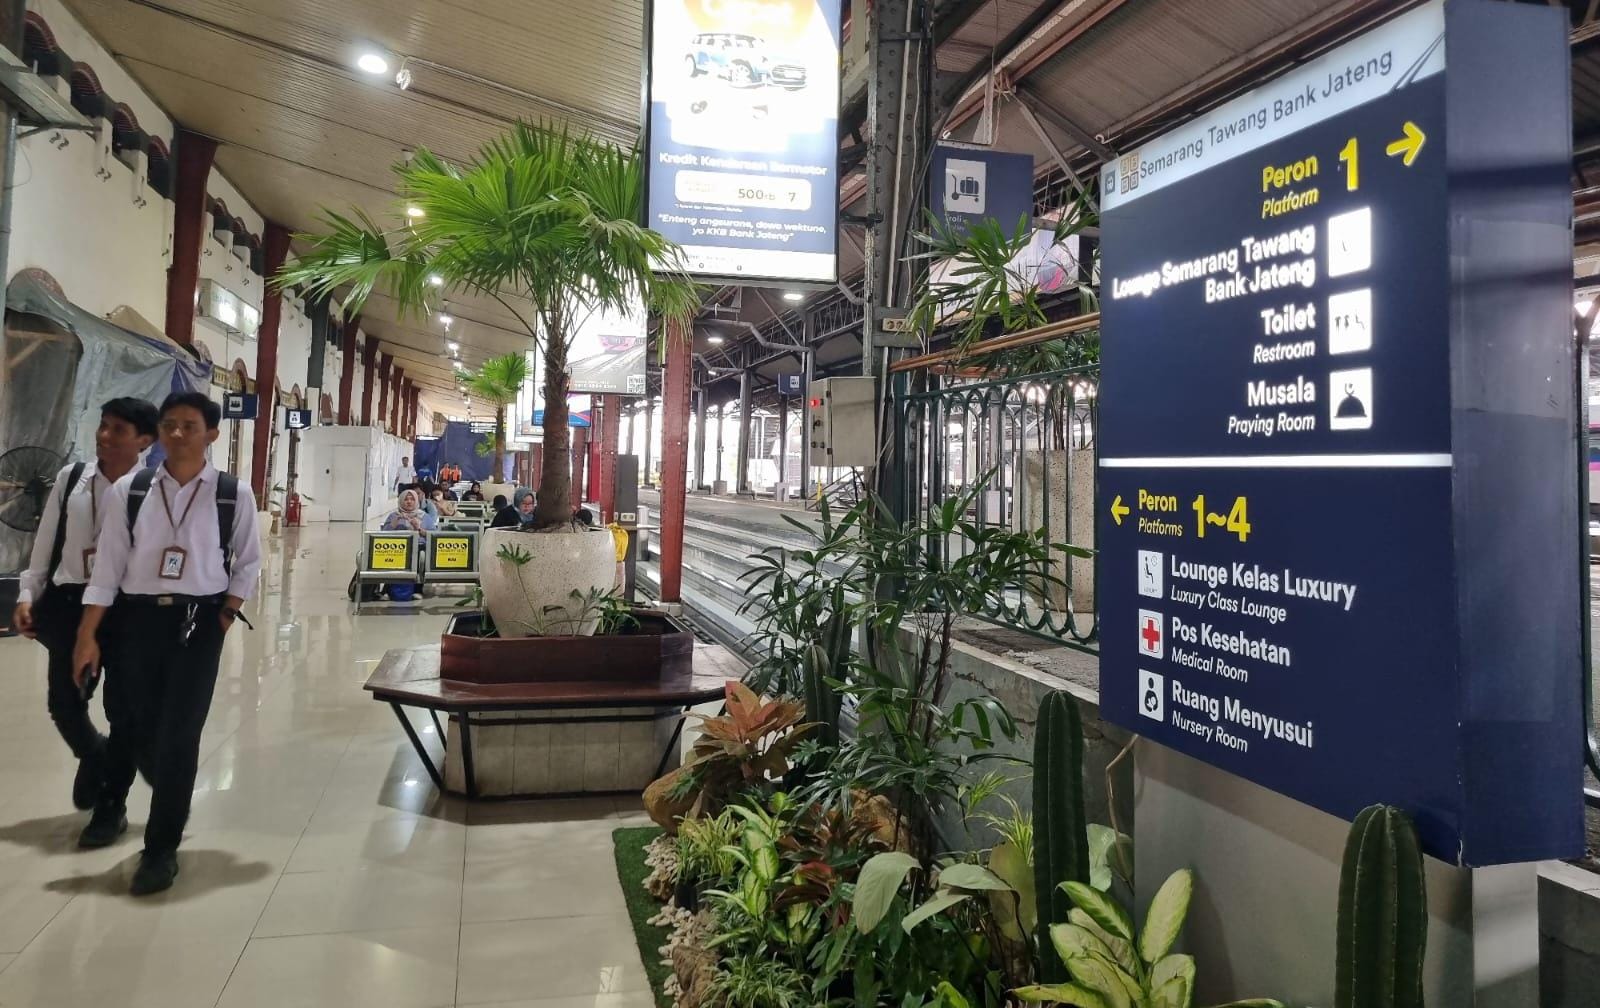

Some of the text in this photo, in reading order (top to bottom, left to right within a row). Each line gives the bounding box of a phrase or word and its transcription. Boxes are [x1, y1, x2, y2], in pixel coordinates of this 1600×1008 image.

[1139, 50, 1393, 179] Semarang Tawang Bank Jateng
[1262, 137, 1359, 192] Peron 1
[788, 192, 797, 203] 7
[1262, 186, 1319, 219] Platform
[729, 227, 754, 238] Bank
[1111, 223, 1317, 300] Lounge Semarang Tawang
[1205, 257, 1317, 303] Bank Jateng
[1261, 302, 1316, 336] Toilet
[1253, 340, 1316, 364] Restroom
[1247, 375, 1316, 407] Musala
[1227, 412, 1316, 437] Praying Room
[1138, 489, 1177, 512] Peron
[1138, 517, 1183, 537] Platforms
[1171, 554, 1357, 612] Lounge Kelas Luxury
[1171, 585, 1287, 625] Luxury Class Lounge
[1172, 616, 1291, 667] Pos Kesehatan
[1171, 646, 1249, 683] Medical Room
[1172, 679, 1313, 748] Ruang Menyusui
[1172, 710, 1249, 753] Nursery Room
